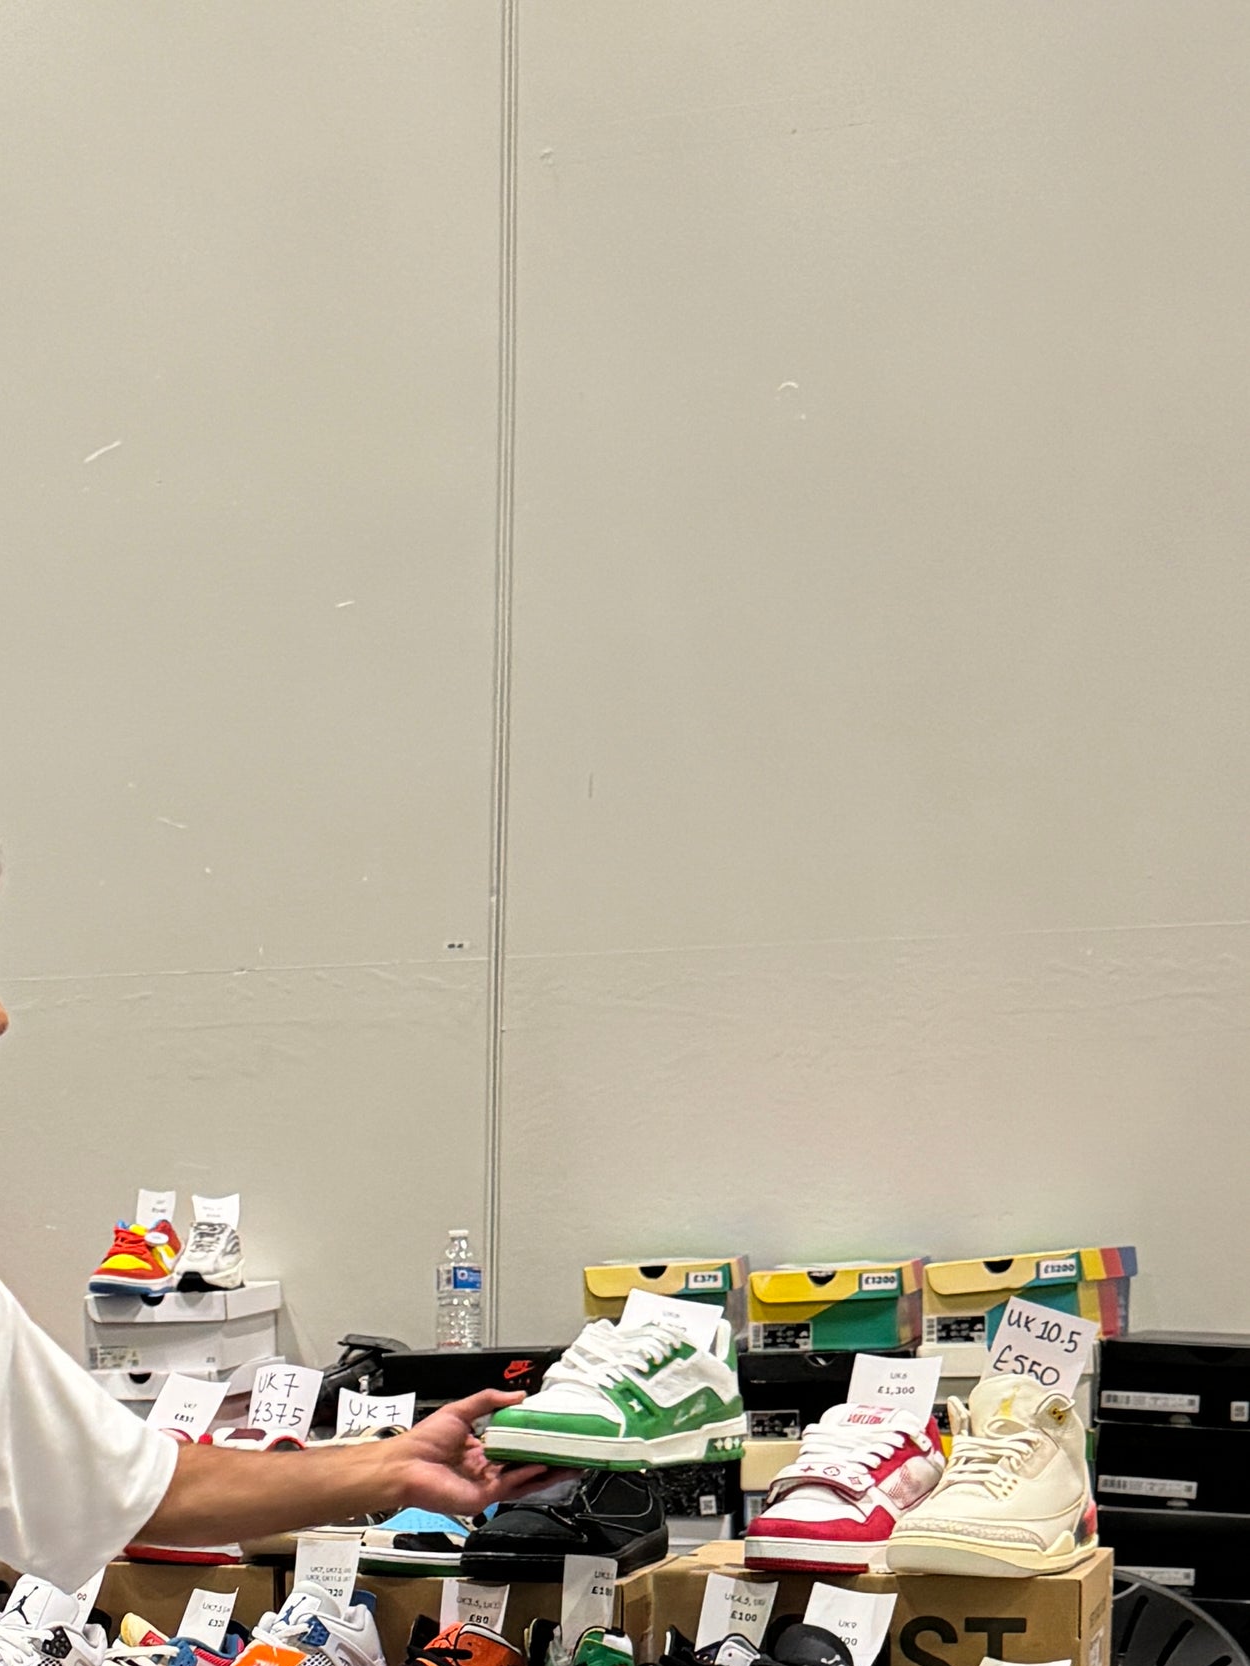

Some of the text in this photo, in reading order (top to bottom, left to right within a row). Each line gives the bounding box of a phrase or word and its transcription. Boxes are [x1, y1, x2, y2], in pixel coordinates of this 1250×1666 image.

[1007, 1308, 1033, 1333] UK
[1036, 1319, 1083, 1354] 10.5
[993, 1344, 1060, 1386] £550
[258, 1372, 300, 1398] UK 7
[251, 1401, 305, 1427] £375
[349, 1399, 401, 1421] UK 7
[468, 1613, 489, 1625] £80
[729, 1609, 757, 1623] £100
